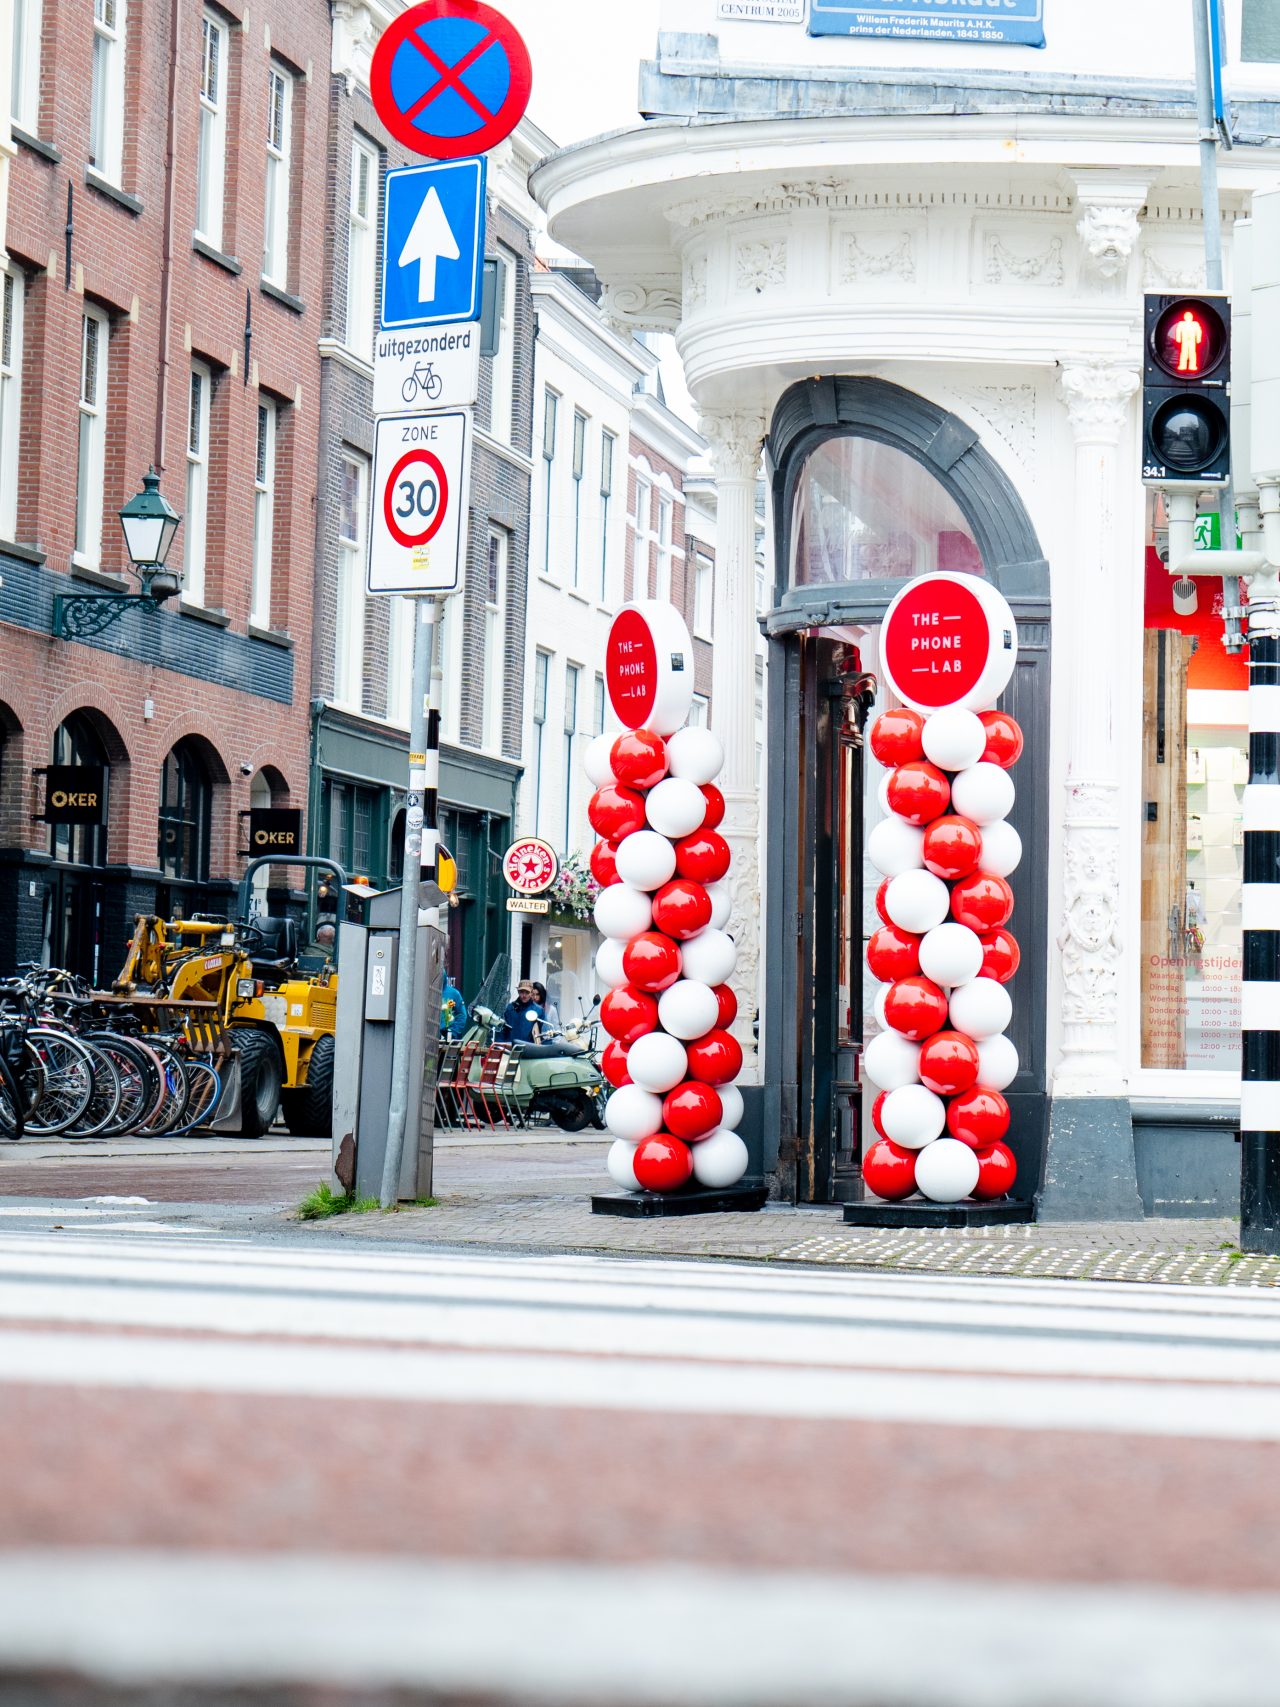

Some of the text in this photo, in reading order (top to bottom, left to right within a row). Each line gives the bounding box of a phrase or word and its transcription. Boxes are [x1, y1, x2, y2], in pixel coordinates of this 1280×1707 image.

[721, 4, 800, 17] CENTRUM 2005
[857, 14, 888, 24] Willem
[890, 17, 928, 26] Frederik
[930, 18, 965, 28] Maurits
[849, 25, 874, 34] prins
[875, 26, 891, 34] der
[892, 27, 955, 38] Nederlanden,
[379, 330, 471, 362] uitgezonderd
[401, 425, 438, 442] ZONE
[1143, 466, 1166, 477] 34.1
[395, 479, 437, 518] 30
[912, 612, 940, 626] THE
[618, 640, 633, 654] THE
[911, 635, 962, 651] PHONE
[619, 661, 645, 677] PHONE
[931, 659, 962, 674] LAB
[630, 684, 647, 698] LAB
[51, 790, 97, 808] OKER
[255, 830, 294, 845] OKER
[510, 901, 546, 910] WALTER
[1150, 972, 1184, 981] Maandag
[1150, 984, 1180, 992] Dinsdag
[1150, 996, 1188, 1004] Woensdag
[1149, 1007, 1190, 1015] Donderdag
[1149, 1019, 1175, 1027] Vrijdag
[1148, 1030, 1182, 1039] Zaterdag
